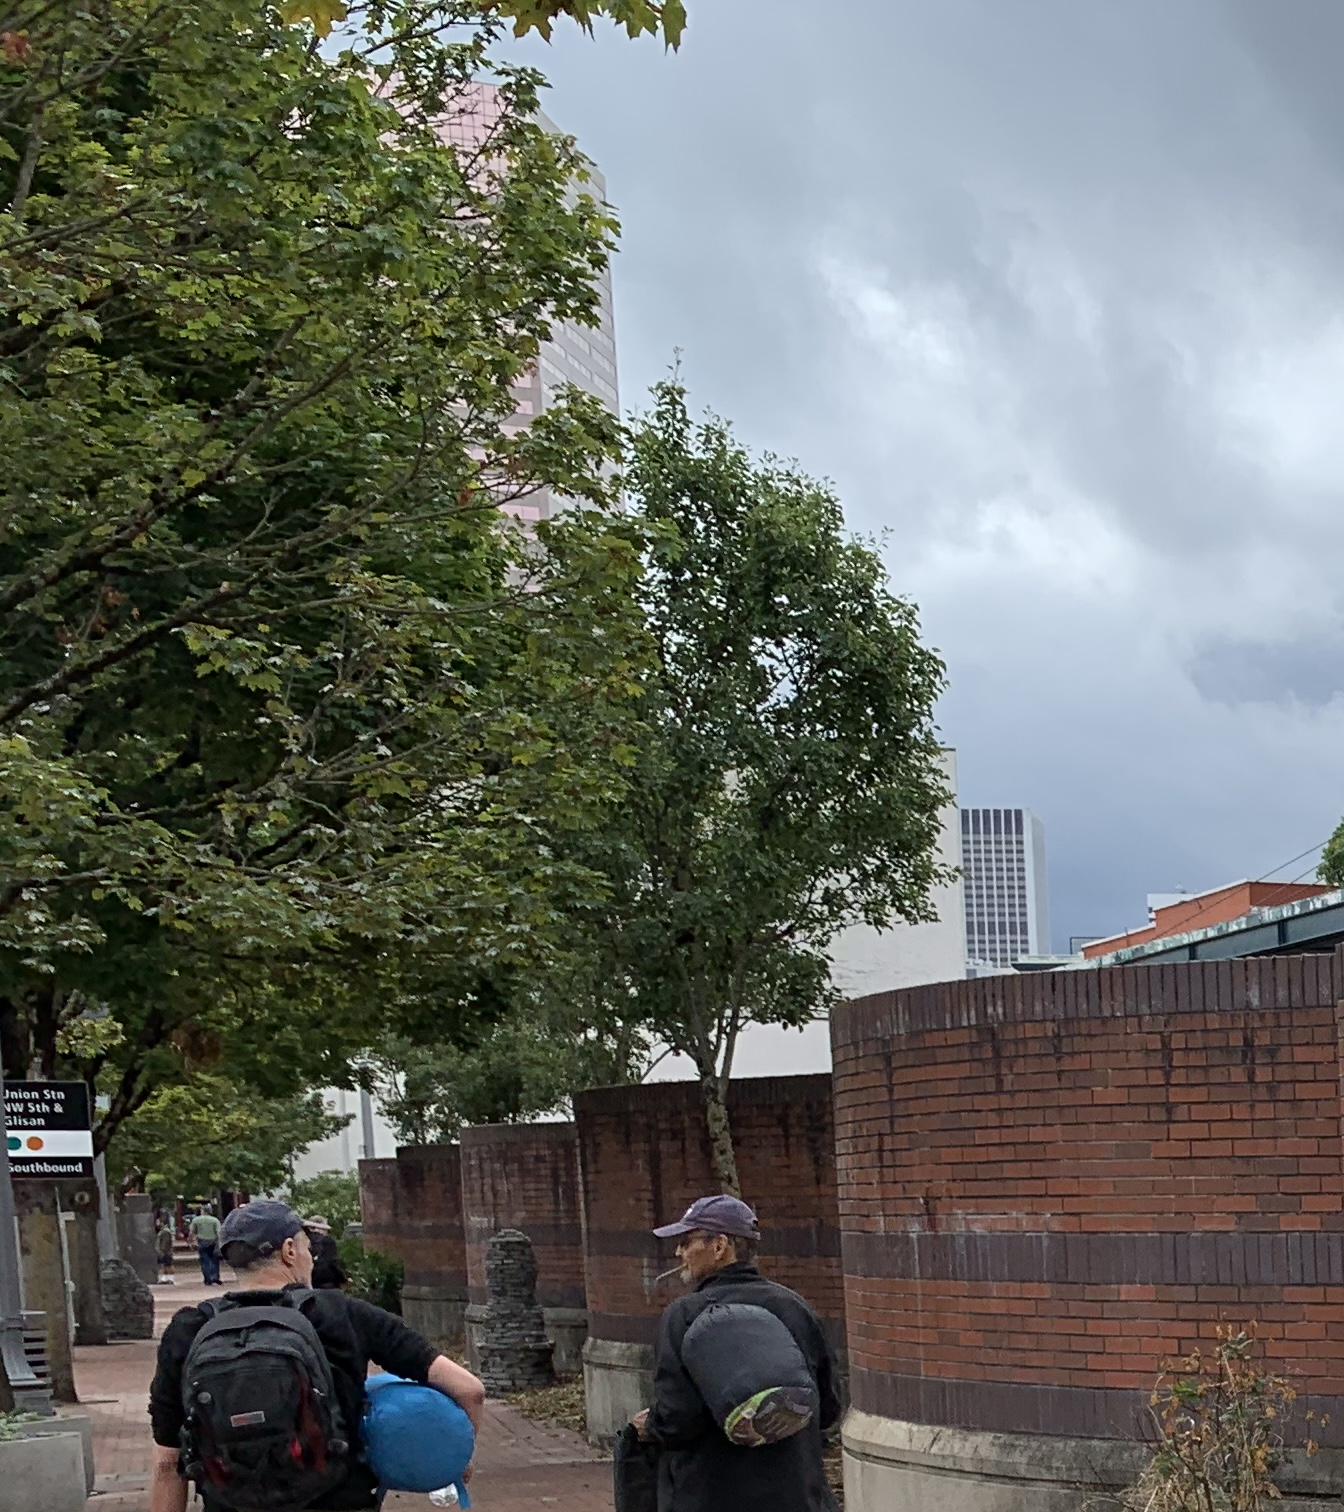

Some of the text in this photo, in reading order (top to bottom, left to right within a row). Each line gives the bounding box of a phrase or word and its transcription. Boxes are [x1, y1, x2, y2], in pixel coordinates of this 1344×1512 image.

[43, 1089, 65, 1099] Stn
[28, 1102, 50, 1112] 5th
[54, 1103, 64, 1113] &
[5, 1115, 46, 1126] Glisan
[8, 1161, 83, 1173] Southbound
